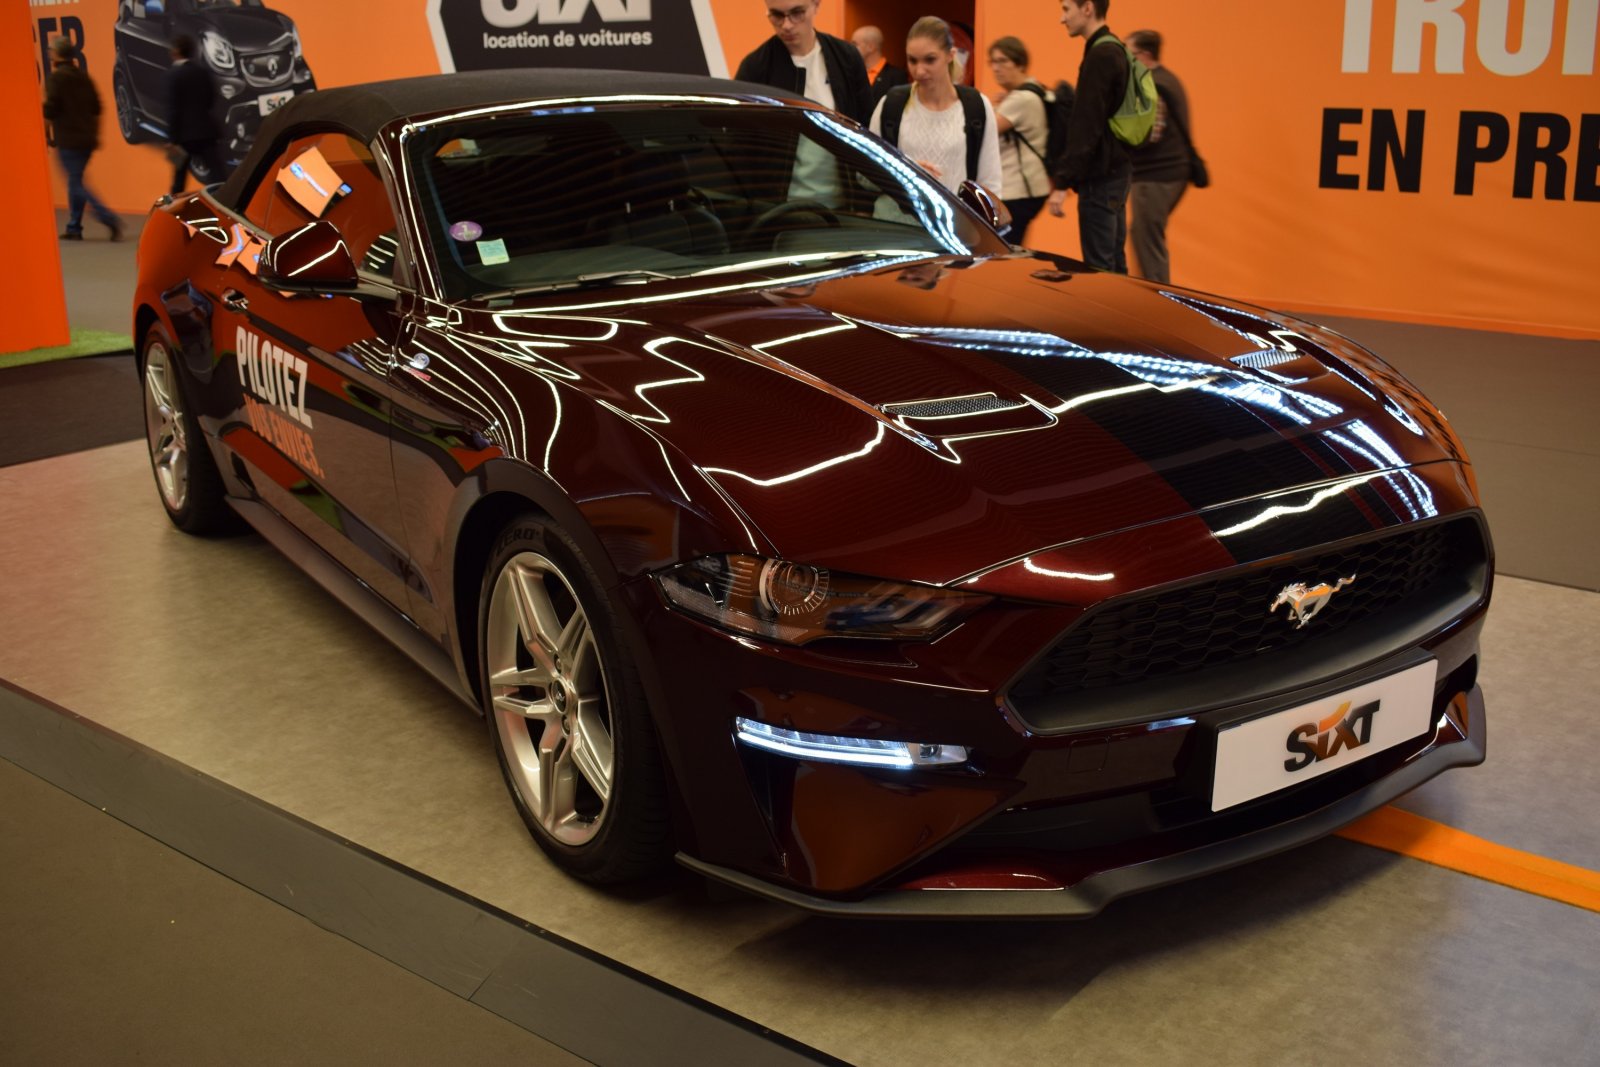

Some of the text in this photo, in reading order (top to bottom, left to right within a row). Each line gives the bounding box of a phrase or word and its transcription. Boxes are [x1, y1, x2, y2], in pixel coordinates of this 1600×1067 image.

[483, 28, 653, 49] location de voitures
[1318, 107, 1426, 194] EN
[236, 325, 313, 429] PILOTEZ
[1284, 699, 1381, 773] SIXT
